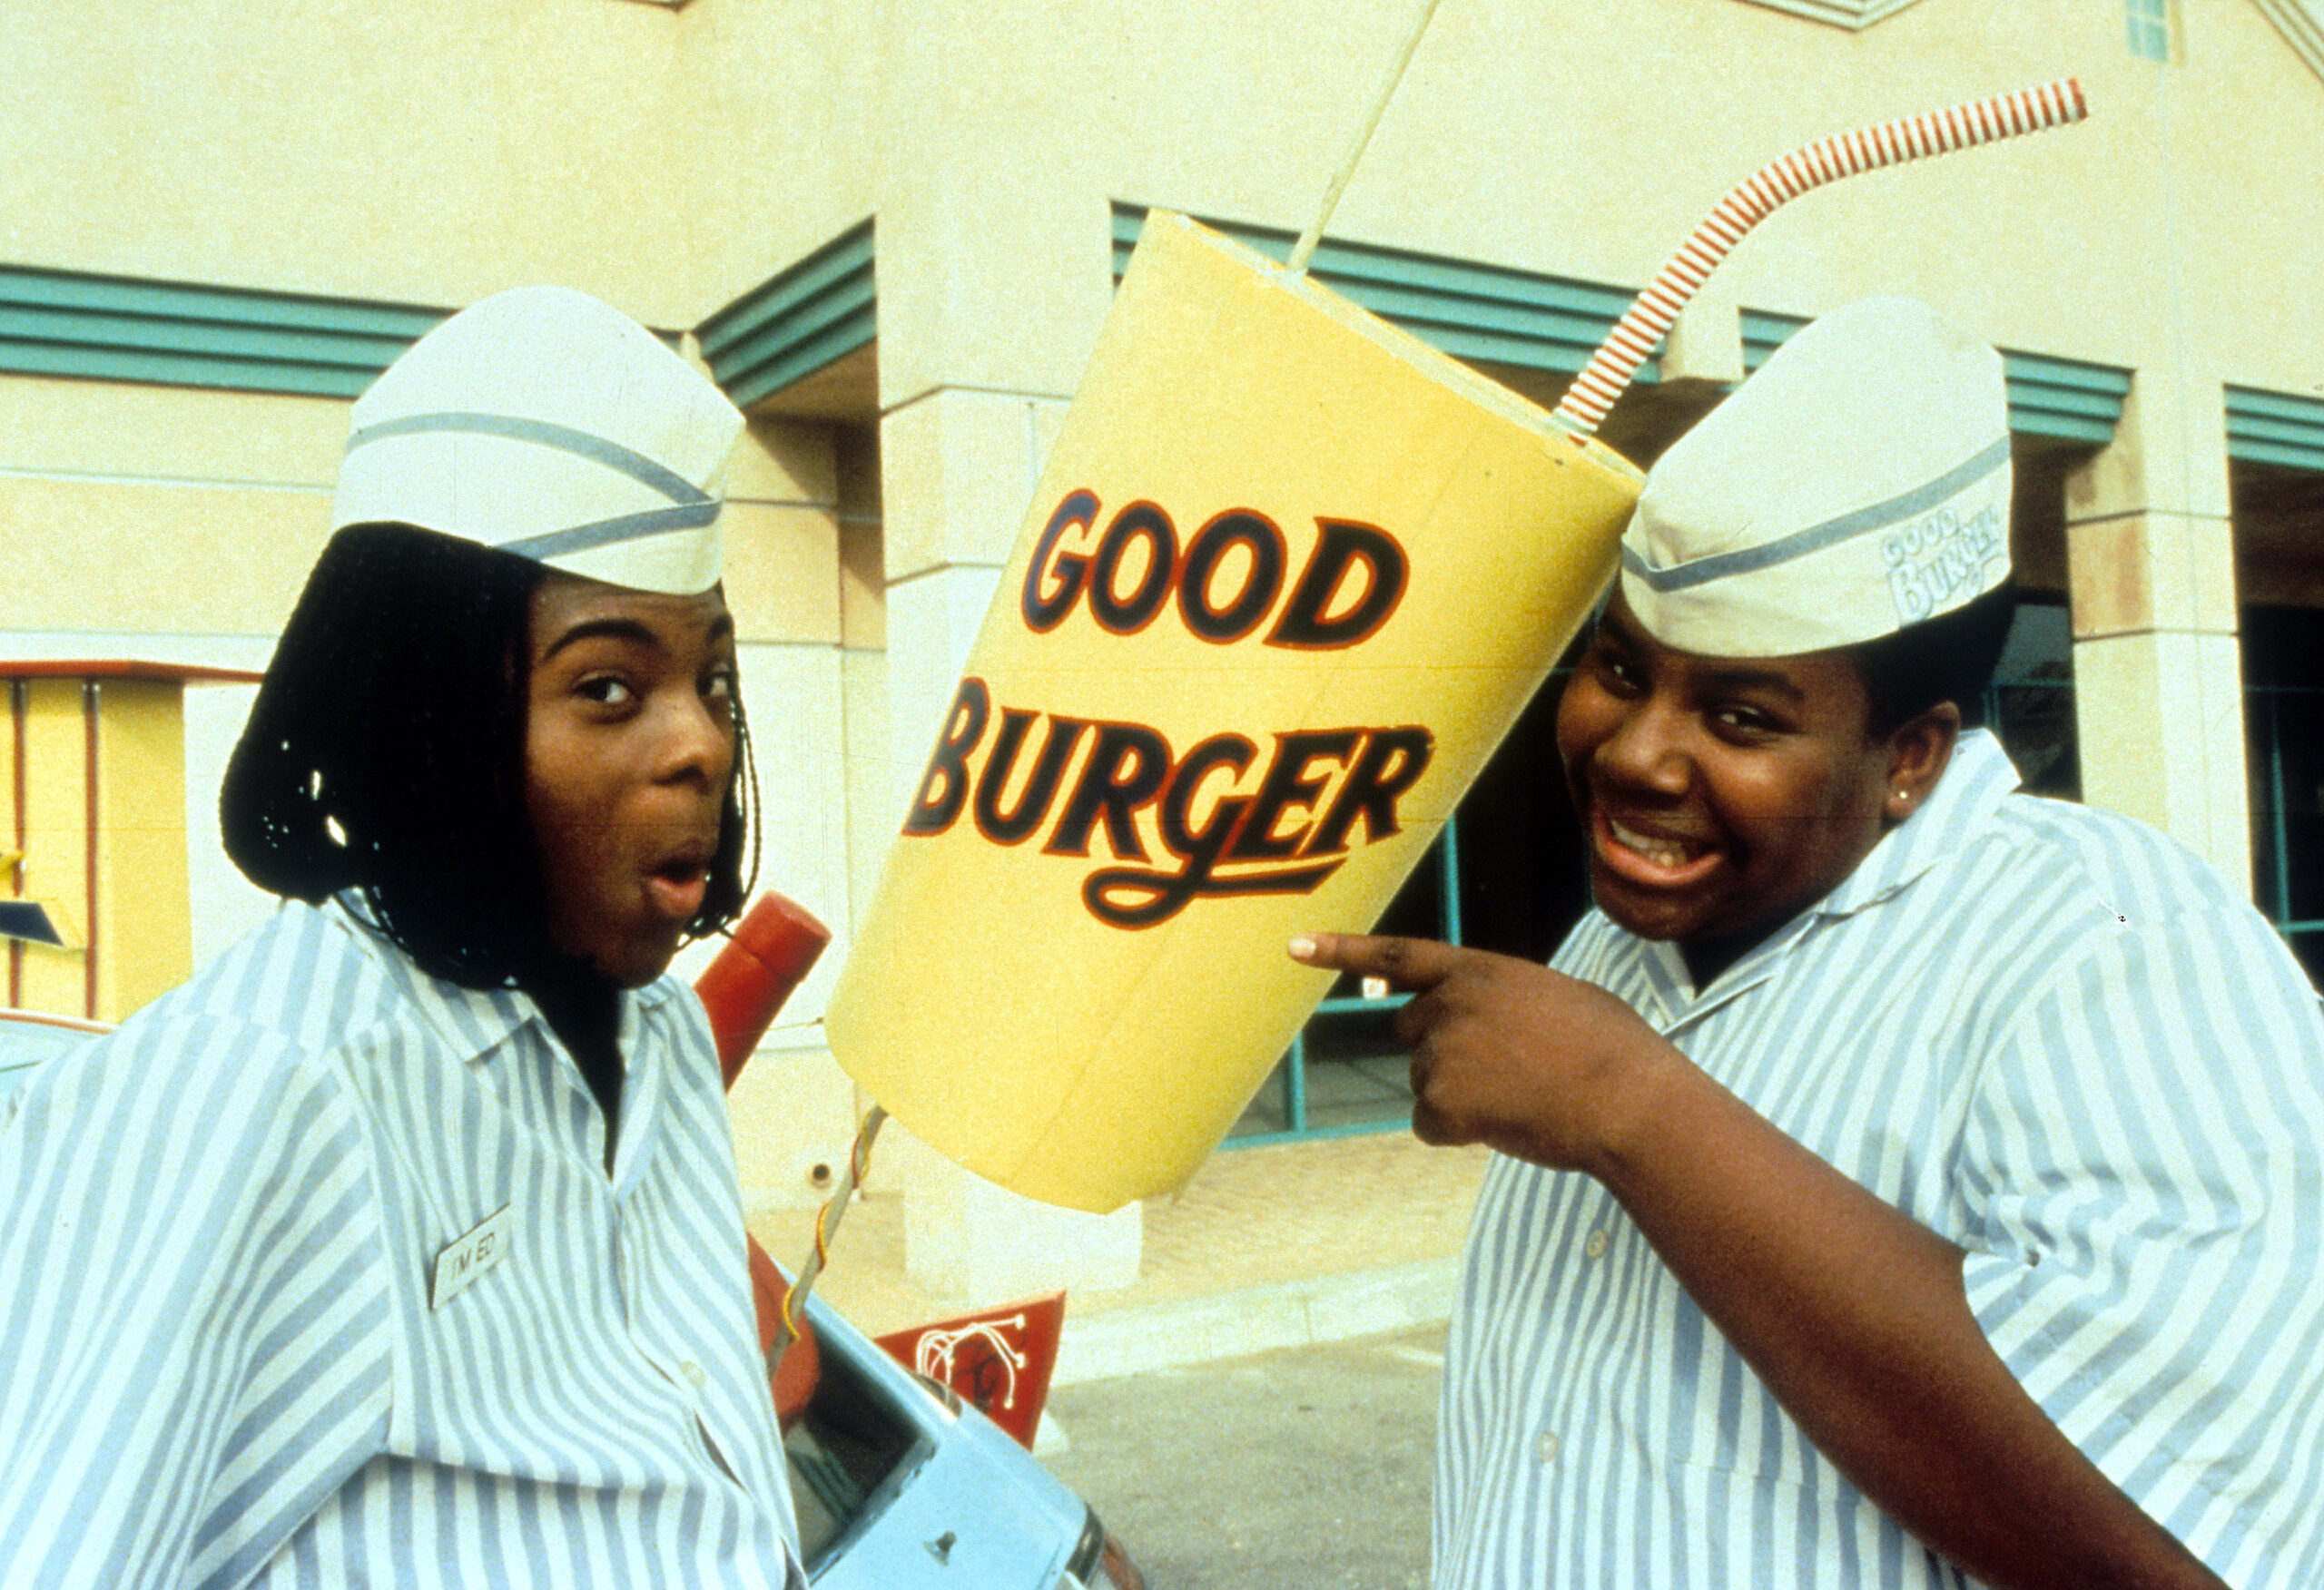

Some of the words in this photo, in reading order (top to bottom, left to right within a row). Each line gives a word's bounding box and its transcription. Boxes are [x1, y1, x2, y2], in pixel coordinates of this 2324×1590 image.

[1020, 487, 1411, 652] GOOD
[1881, 508, 1961, 568] GOOD
[901, 676, 1436, 932] BURGER
[476, 1232, 496, 1263] ED
